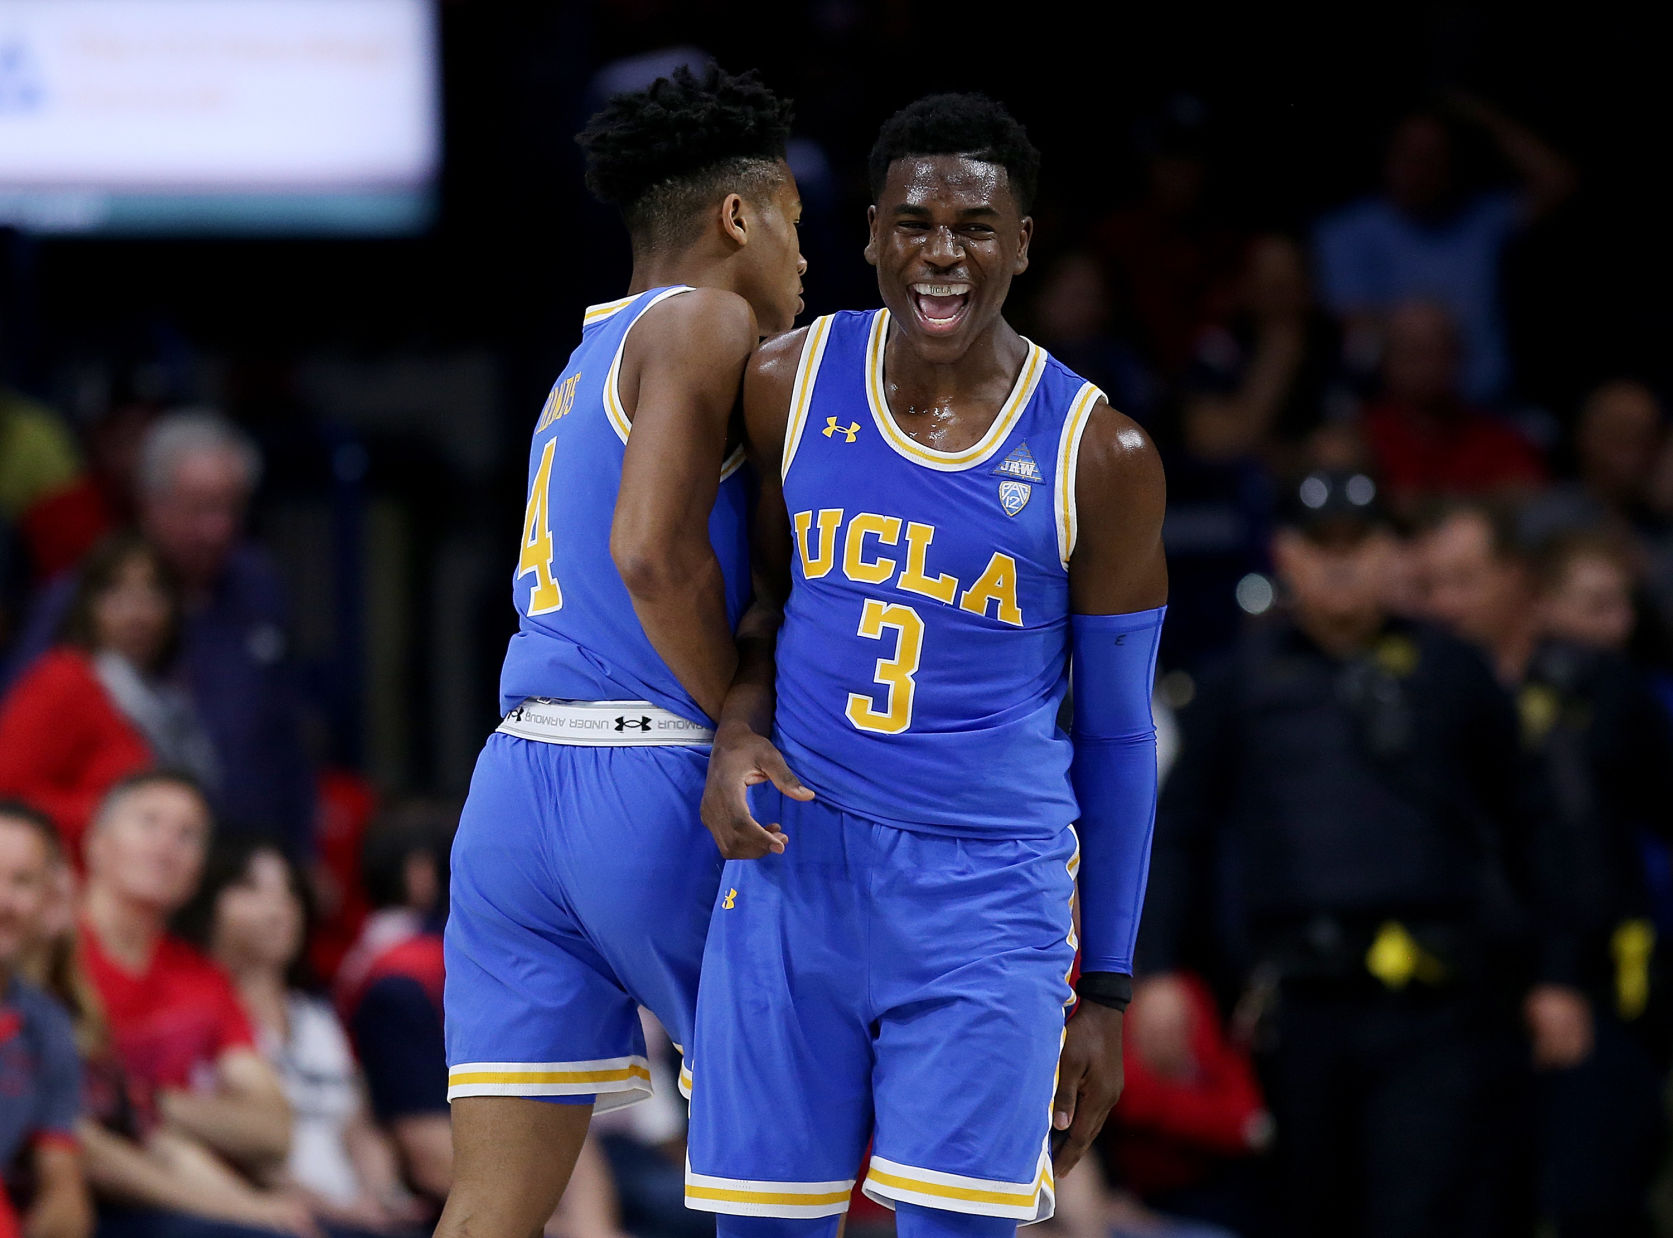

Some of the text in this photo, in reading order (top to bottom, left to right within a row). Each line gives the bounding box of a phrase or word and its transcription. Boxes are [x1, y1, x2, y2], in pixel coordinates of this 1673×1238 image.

[1000, 460, 1035, 477] JRW
[1001, 483, 1028, 502] PAC
[1005, 496, 1020, 509] 12
[516, 436, 563, 618] 4
[793, 508, 1024, 627] UCLA
[844, 597, 926, 735] 3
[569, 719, 610, 730] UNDER
[657, 719, 710, 730] MOUR
